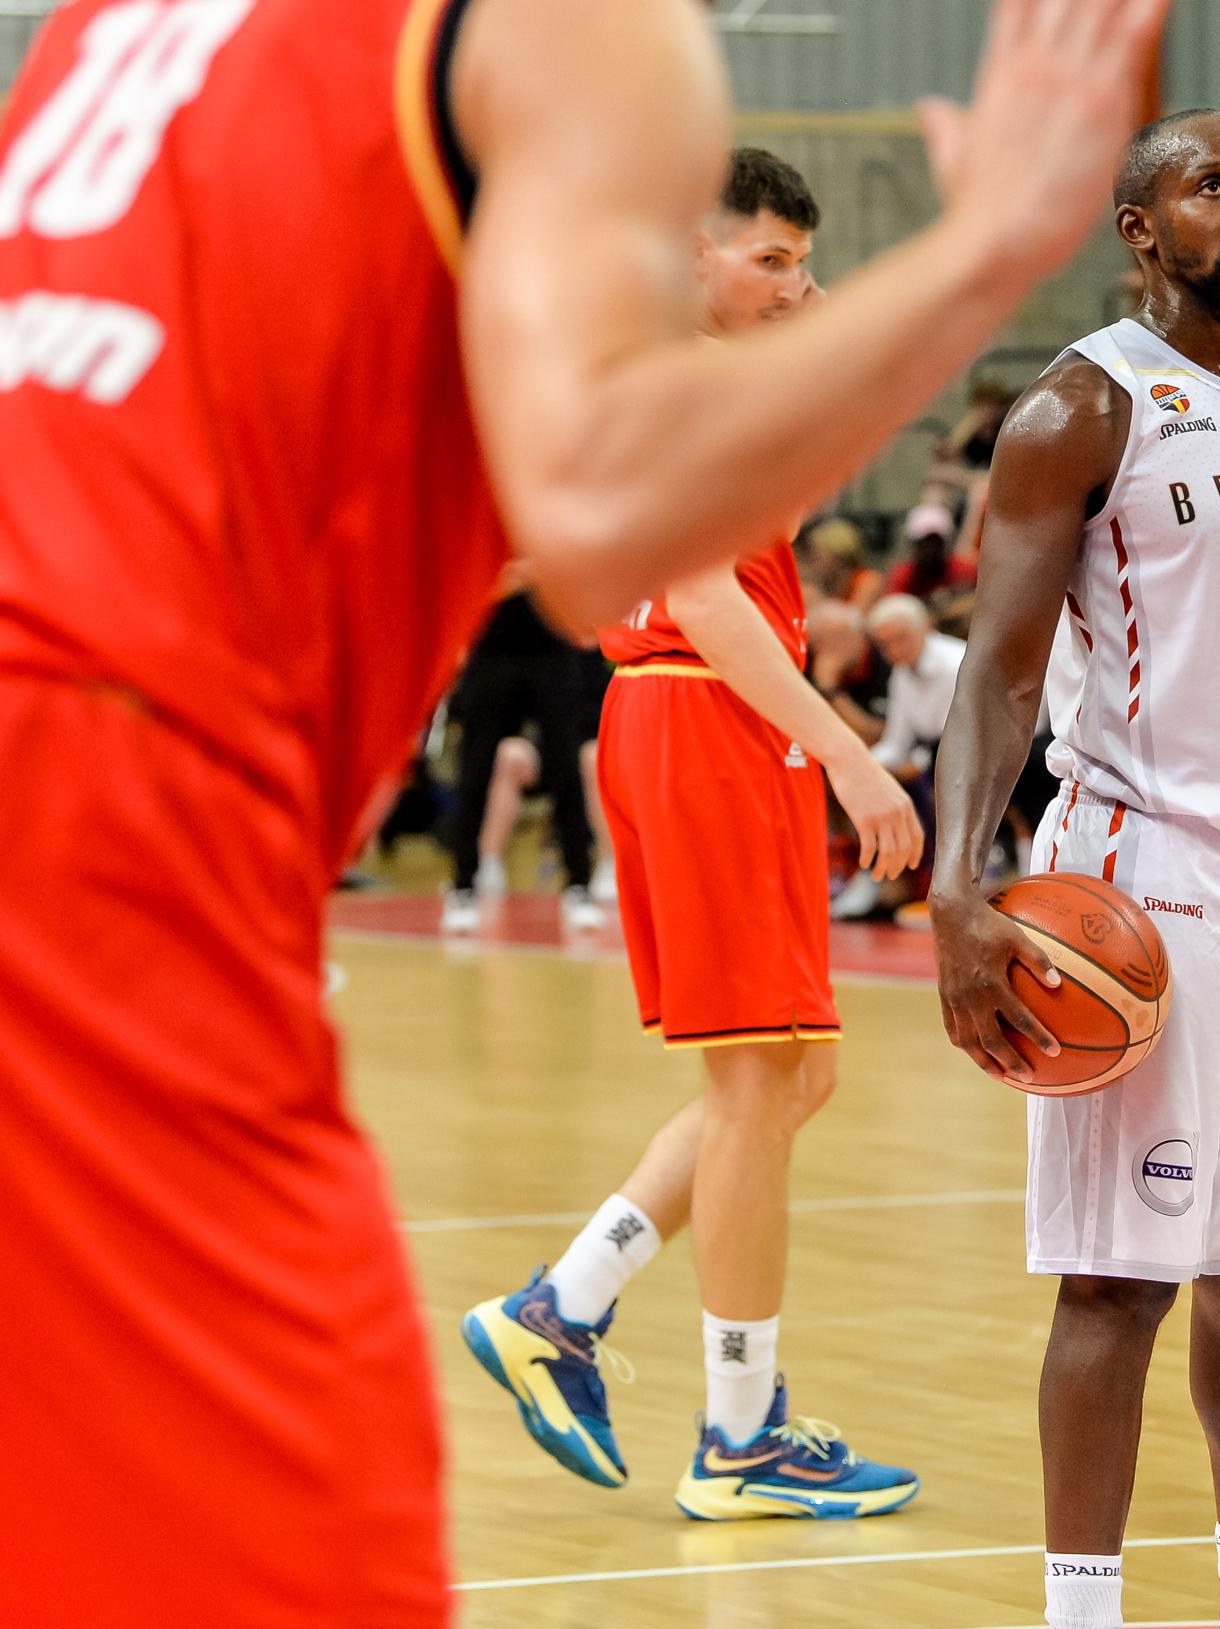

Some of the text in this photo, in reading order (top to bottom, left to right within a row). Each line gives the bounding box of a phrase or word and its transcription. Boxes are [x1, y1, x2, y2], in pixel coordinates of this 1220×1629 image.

[0, 0, 256, 238] 18
[1159, 416, 1217, 441] SPALDING
[1143, 896, 1203, 920] SPALDING
